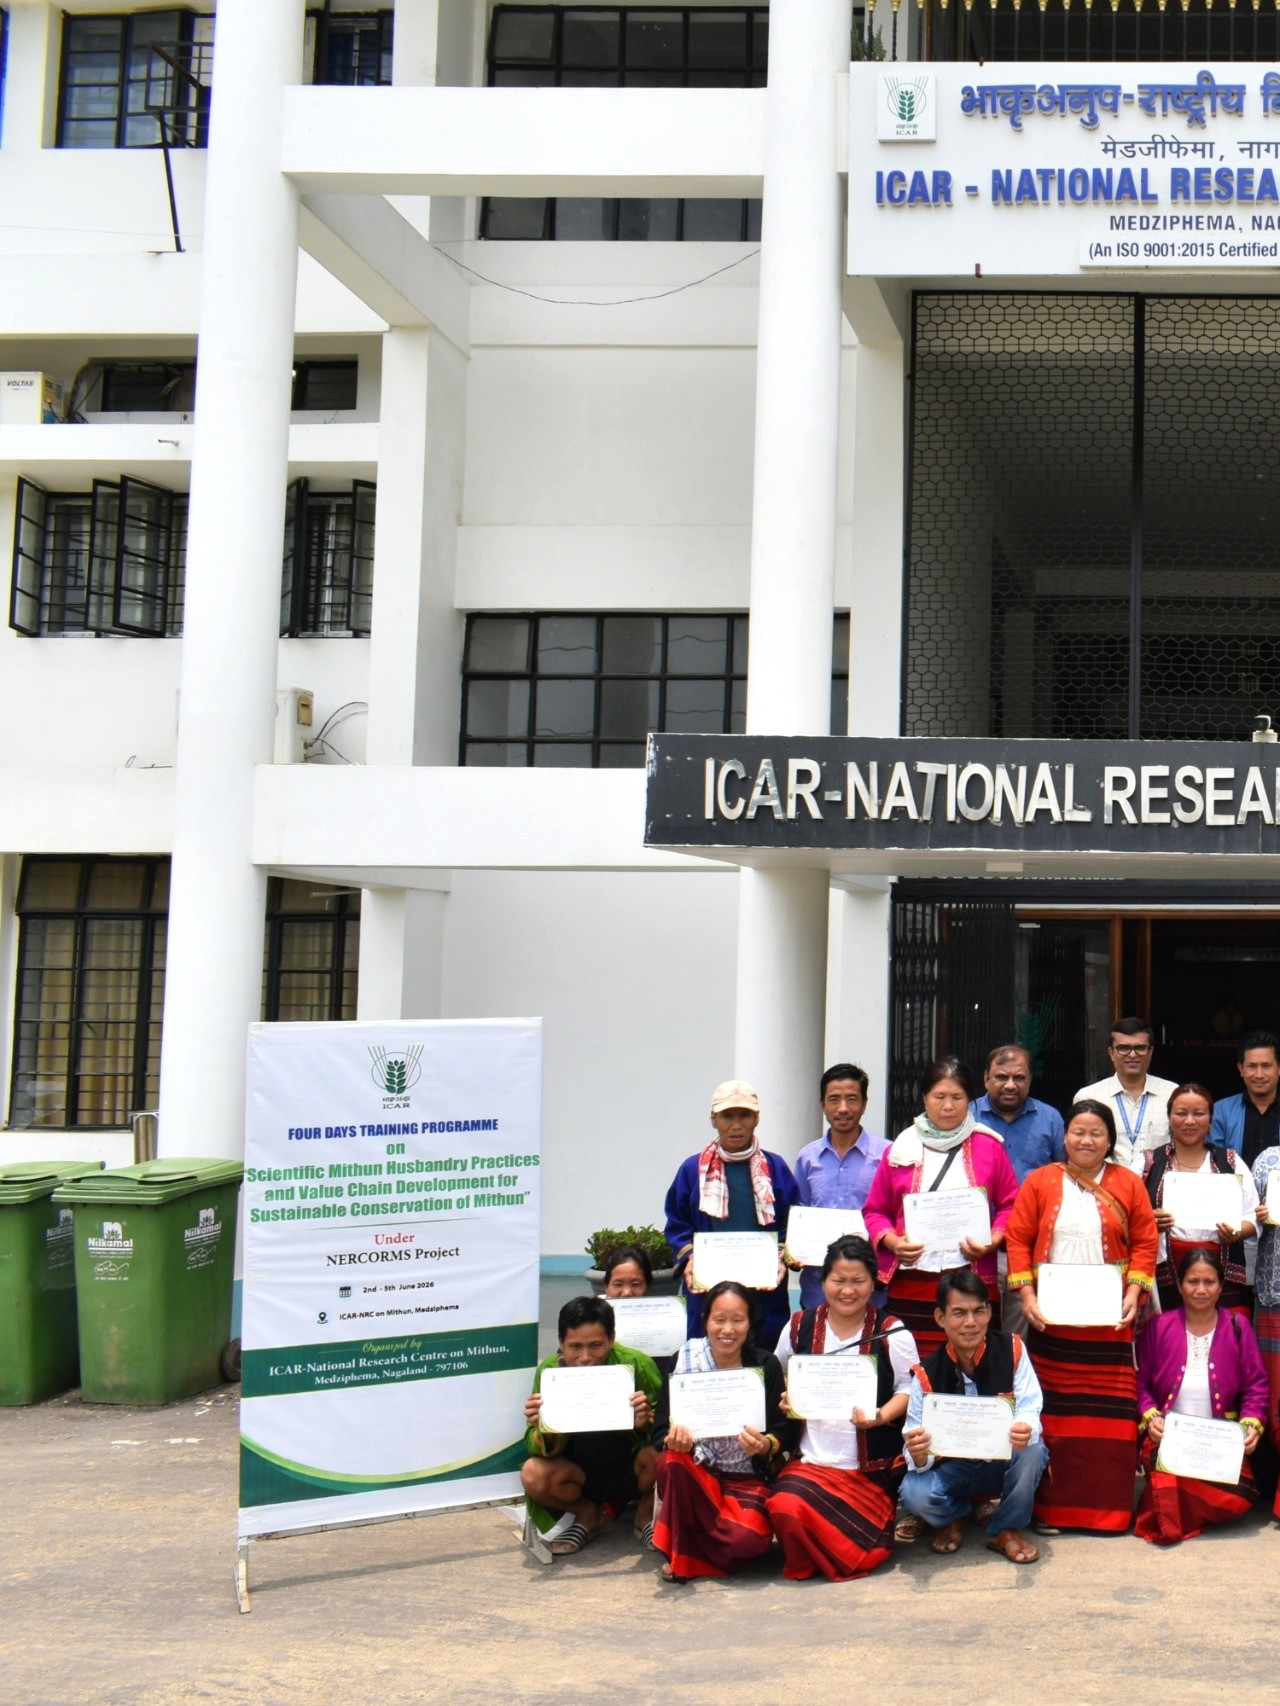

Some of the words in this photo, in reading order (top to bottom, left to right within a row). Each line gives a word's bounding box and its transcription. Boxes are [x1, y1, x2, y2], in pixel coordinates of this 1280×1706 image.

[960, 70, 1246, 130] भाकृअनुप-राष्ट्रीय
[1101, 135, 1225, 162] मेडजीफेमा,
[876, 170, 953, 206] ICAR
[965, 184, 979, 197] -
[991, 168, 1158, 206] NATIONAL
[1109, 215, 1242, 233] MEDZIPHEMA,
[1088, 243, 1112, 259] (An
[1116, 243, 1139, 257] ISO
[1143, 243, 1215, 258] 9001:2015
[1219, 242, 1278, 257] Certified
[705, 758, 1093, 824] ICAR-NATIONAL
[288, 1127, 322, 1140] FOUR
[325, 1126, 357, 1139] DAYS
[360, 1122, 418, 1137] TRAINING
[421, 1119, 499, 1134] PROGRAMME
[386, 1143, 406, 1155] on
[328, 1163, 383, 1178] Mithun
[386, 1158, 468, 1174] Husbandry
[471, 1154, 540, 1170] Practices
[264, 1186, 295, 1201] and
[299, 1185, 344, 1200] Value
[347, 1181, 393, 1197] Chain
[396, 1175, 495, 1194] Development
[498, 1174, 519, 1187] for
[250, 1204, 347, 1223] Sustainable
[350, 1197, 453, 1216] Conservation
[456, 1195, 471, 1209] of
[46, 1225, 73, 1238] Nilkam
[184, 1221, 222, 1238] Nilkamal
[374, 1232, 415, 1245] Under
[88, 1238, 133, 1247] Nilkamal
[326, 1249, 411, 1266] NERCORMS
[415, 1247, 460, 1261] Project
[384, 1284, 396, 1292] 5th
[399, 1283, 415, 1291] June
[340, 1311, 374, 1320] ICAR-NRC
[386, 1308, 414, 1316] Mithun,
[415, 1304, 459, 1313] Medziphema
[362, 1339, 408, 1355] Organized
[410, 1338, 422, 1350] by
[269, 1359, 355, 1376] ICAR-National
[359, 1354, 408, 1367] Research
[411, 1351, 448, 1362] Centre
[450, 1349, 463, 1358] on
[466, 1345, 510, 1357] Mithun,
[314, 1372, 380, 1385] Medziphema,
[382, 1365, 427, 1379] Nagaland
[435, 1361, 469, 1372] 797106
